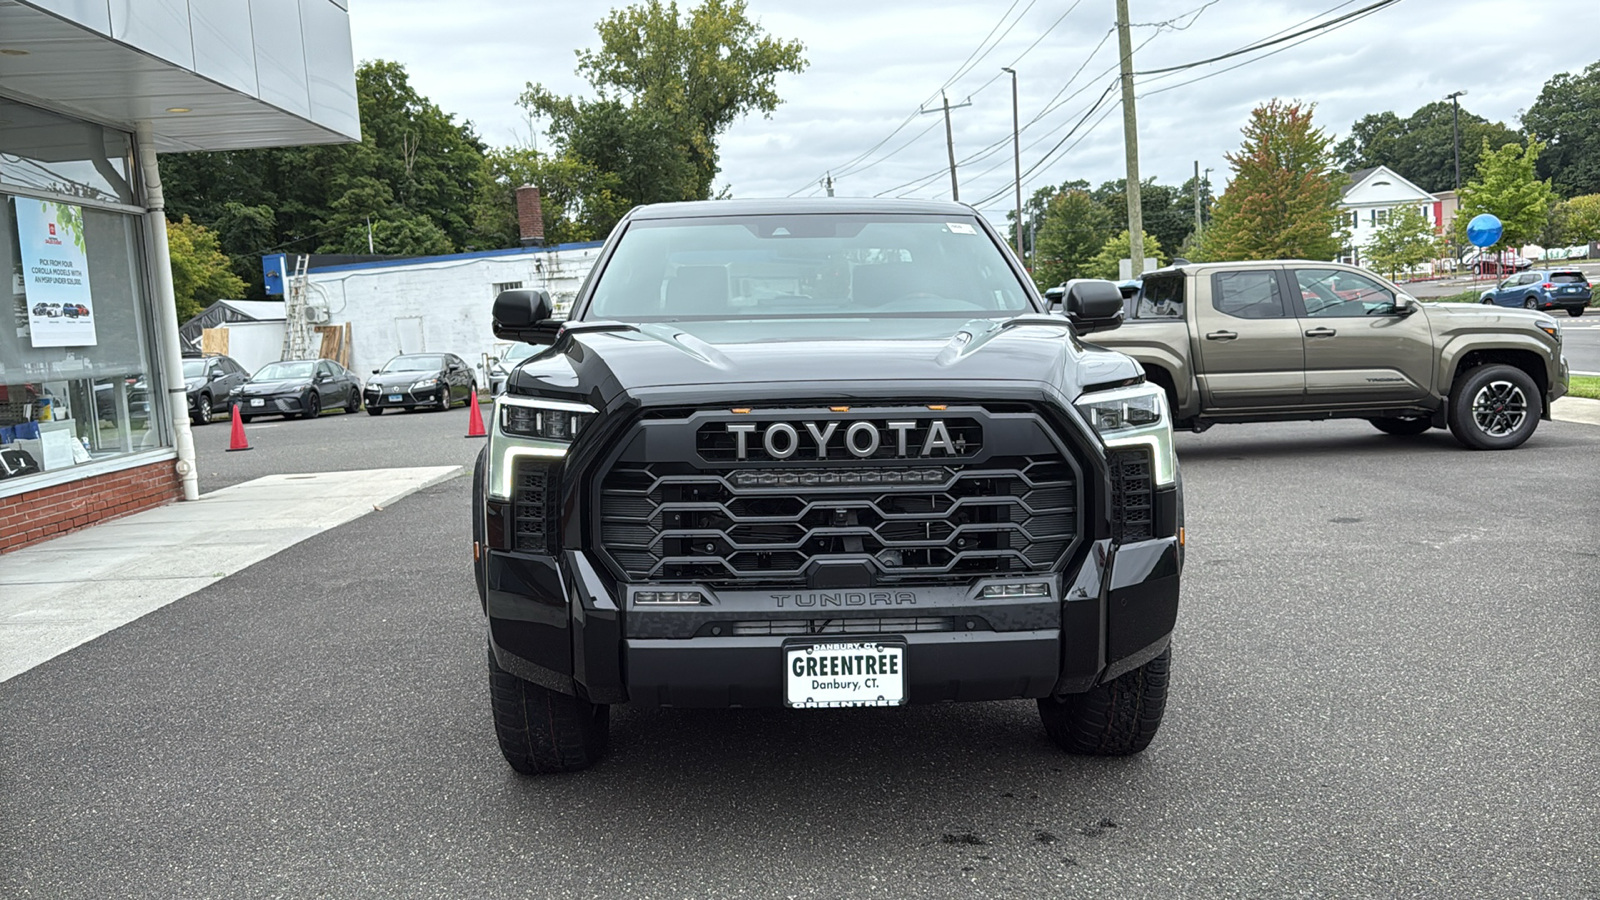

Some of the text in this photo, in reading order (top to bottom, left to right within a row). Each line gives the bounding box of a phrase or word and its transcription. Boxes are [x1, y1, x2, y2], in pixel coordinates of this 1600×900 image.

[39, 258, 73, 268] PICK FROM FOUR
[31, 266, 53, 275] COROLLA
[53, 268, 71, 276] MODELS
[726, 420, 957, 460] TOYOTA
[770, 591, 917, 608] TUNDRA
[813, 643, 861, 651] DANBURY,
[792, 654, 898, 677] GREENTREE
[812, 678, 879, 692] Danbury, CT.
[792, 700, 900, 709] GREENTREE
